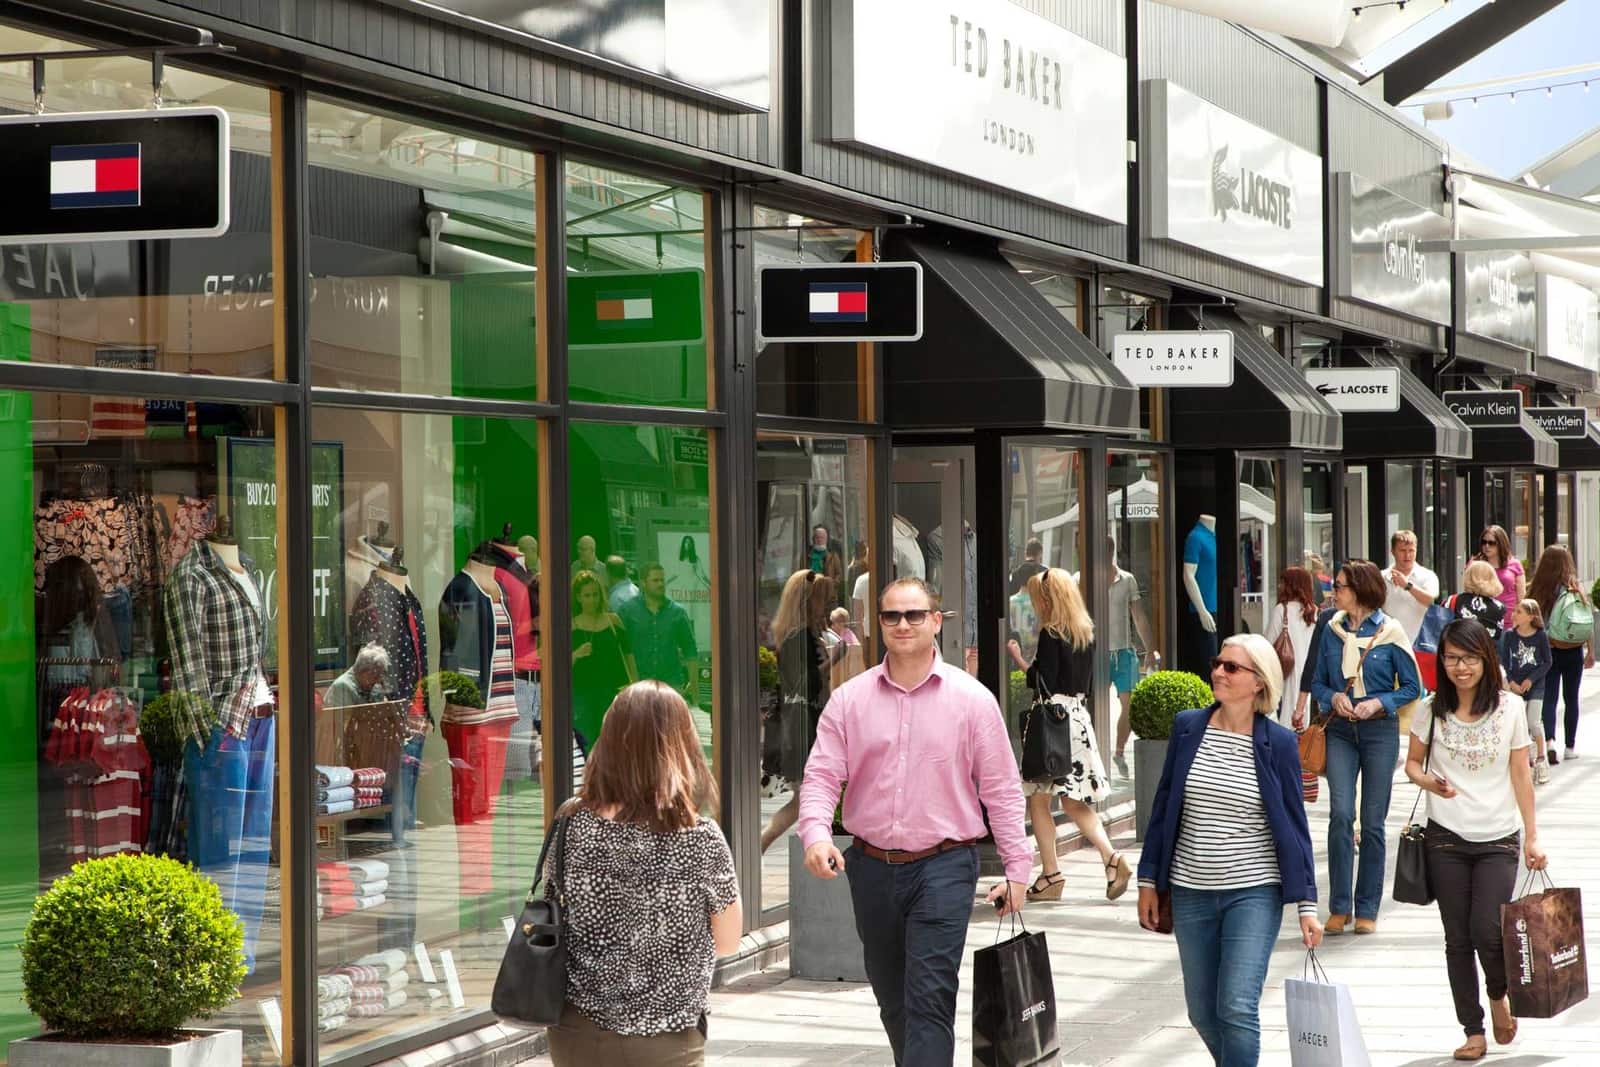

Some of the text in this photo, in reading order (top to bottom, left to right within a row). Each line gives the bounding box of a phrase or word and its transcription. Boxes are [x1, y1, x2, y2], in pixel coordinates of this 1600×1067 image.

[950, 14, 1062, 110] TED BAKER
[983, 118, 1034, 155] LONDON
[1241, 167, 1291, 229] LACOSTE
[1125, 347, 1219, 359] TED BAKER
[1340, 385, 1389, 394] LACOSTE
[1449, 401, 1517, 416] Calvin Klein
[1535, 415, 1582, 427] alvin Klein
[247, 483, 263, 506] BUY
[1298, 1031, 1328, 1048] JAEGER
